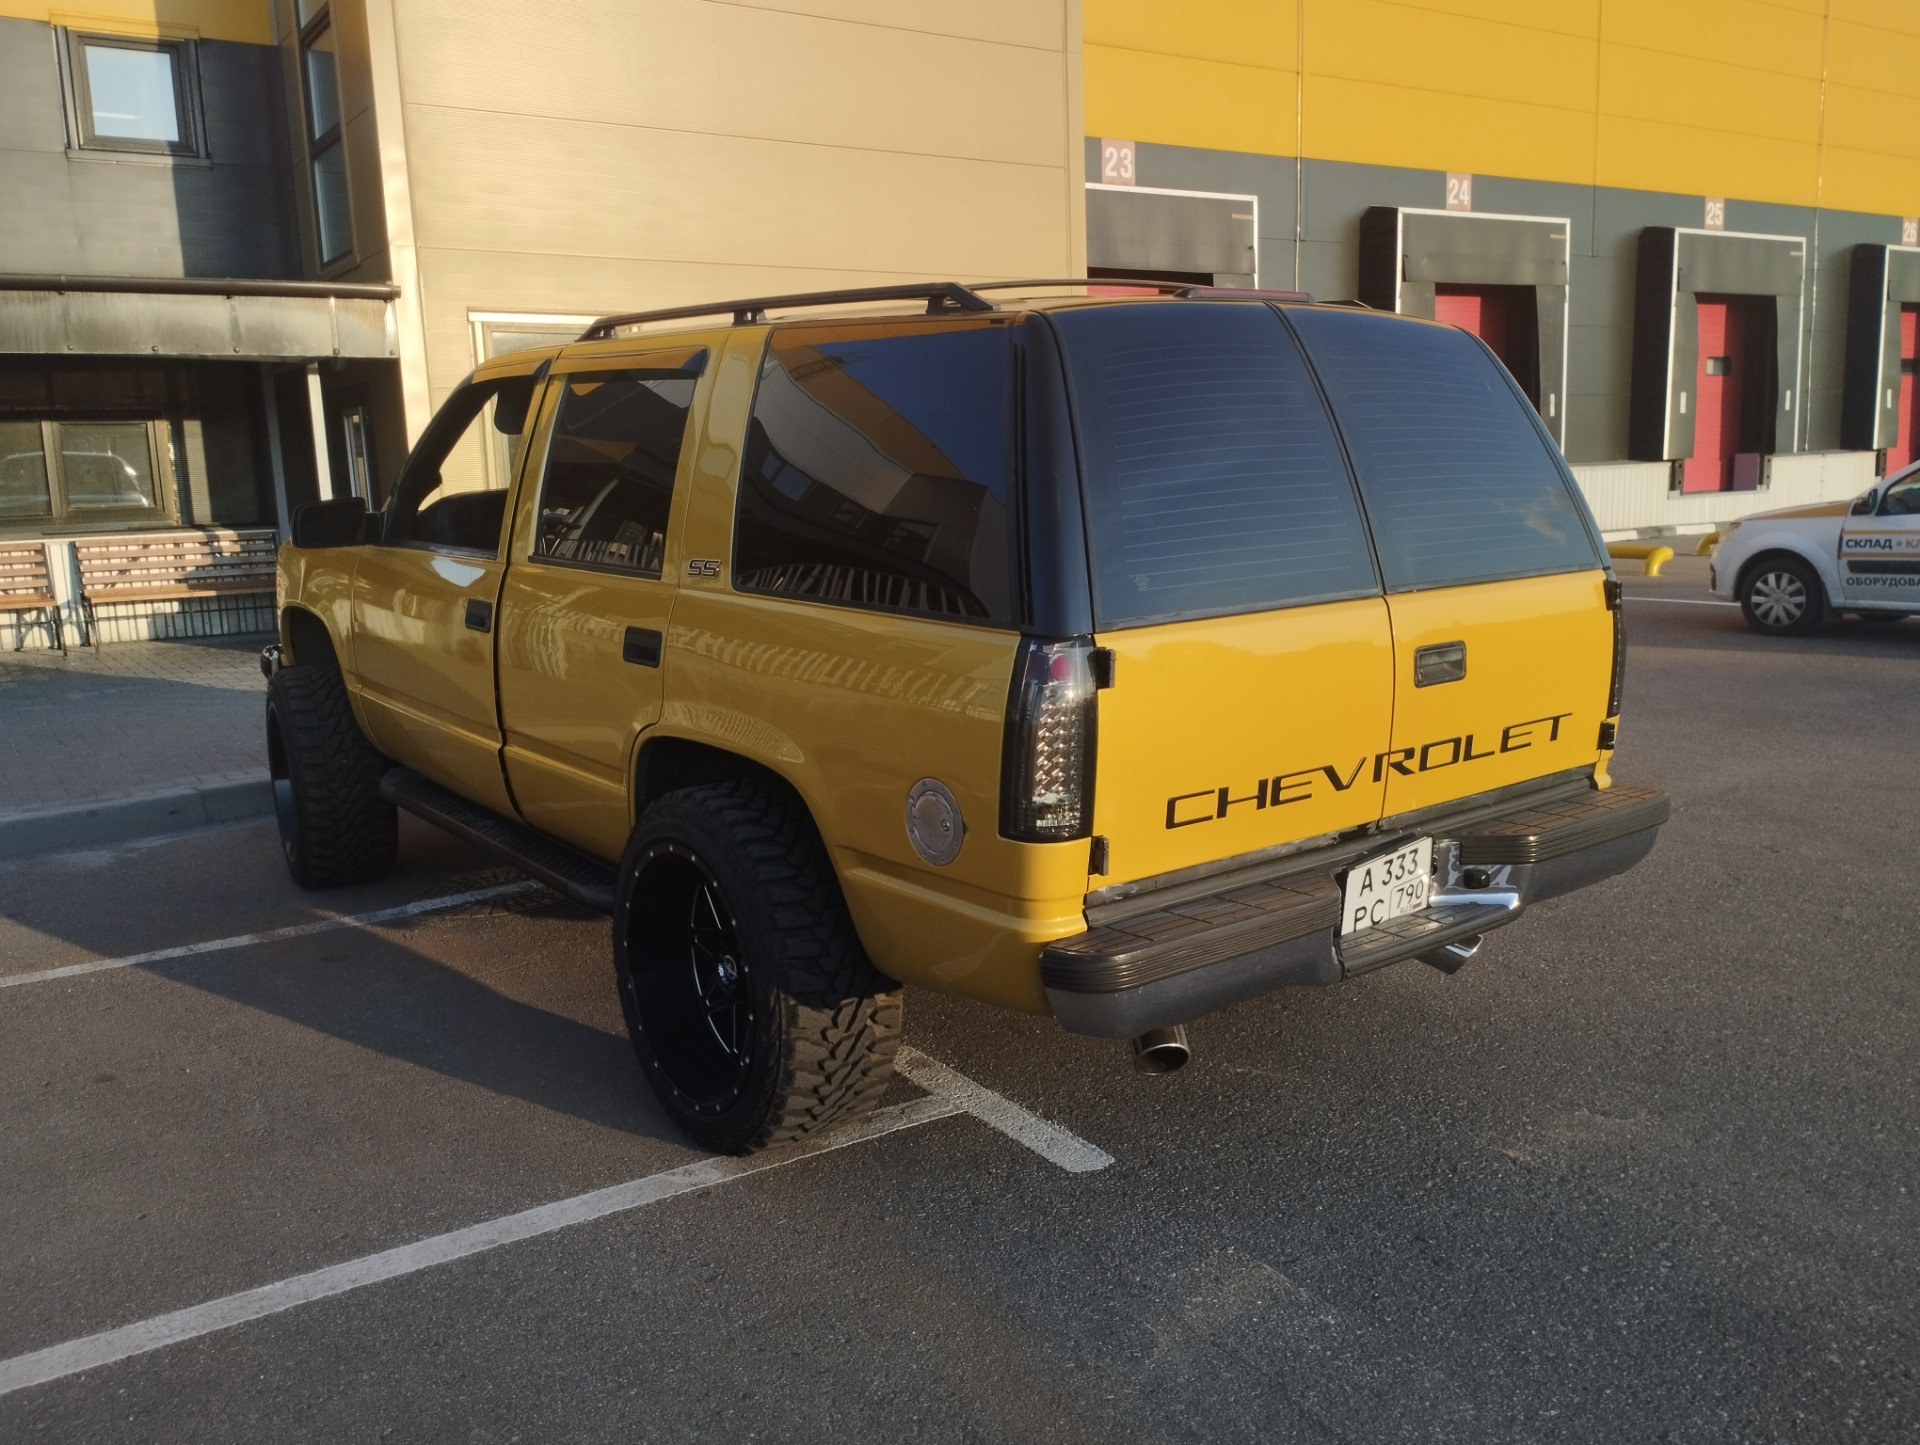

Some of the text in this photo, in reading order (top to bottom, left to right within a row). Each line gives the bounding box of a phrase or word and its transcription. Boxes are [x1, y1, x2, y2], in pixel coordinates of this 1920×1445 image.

[1105, 146, 1133, 178] 23
[1448, 178, 1469, 205] 24
[1706, 202, 1723, 226] 25
[1903, 222, 1918, 243] 26
[1846, 539, 1893, 550] СКЛАД
[688, 558, 722, 579] SS
[1165, 712, 1573, 830] CHEVROLET
[1382, 848, 1419, 886] 333
[1396, 880, 1424, 909] 790
